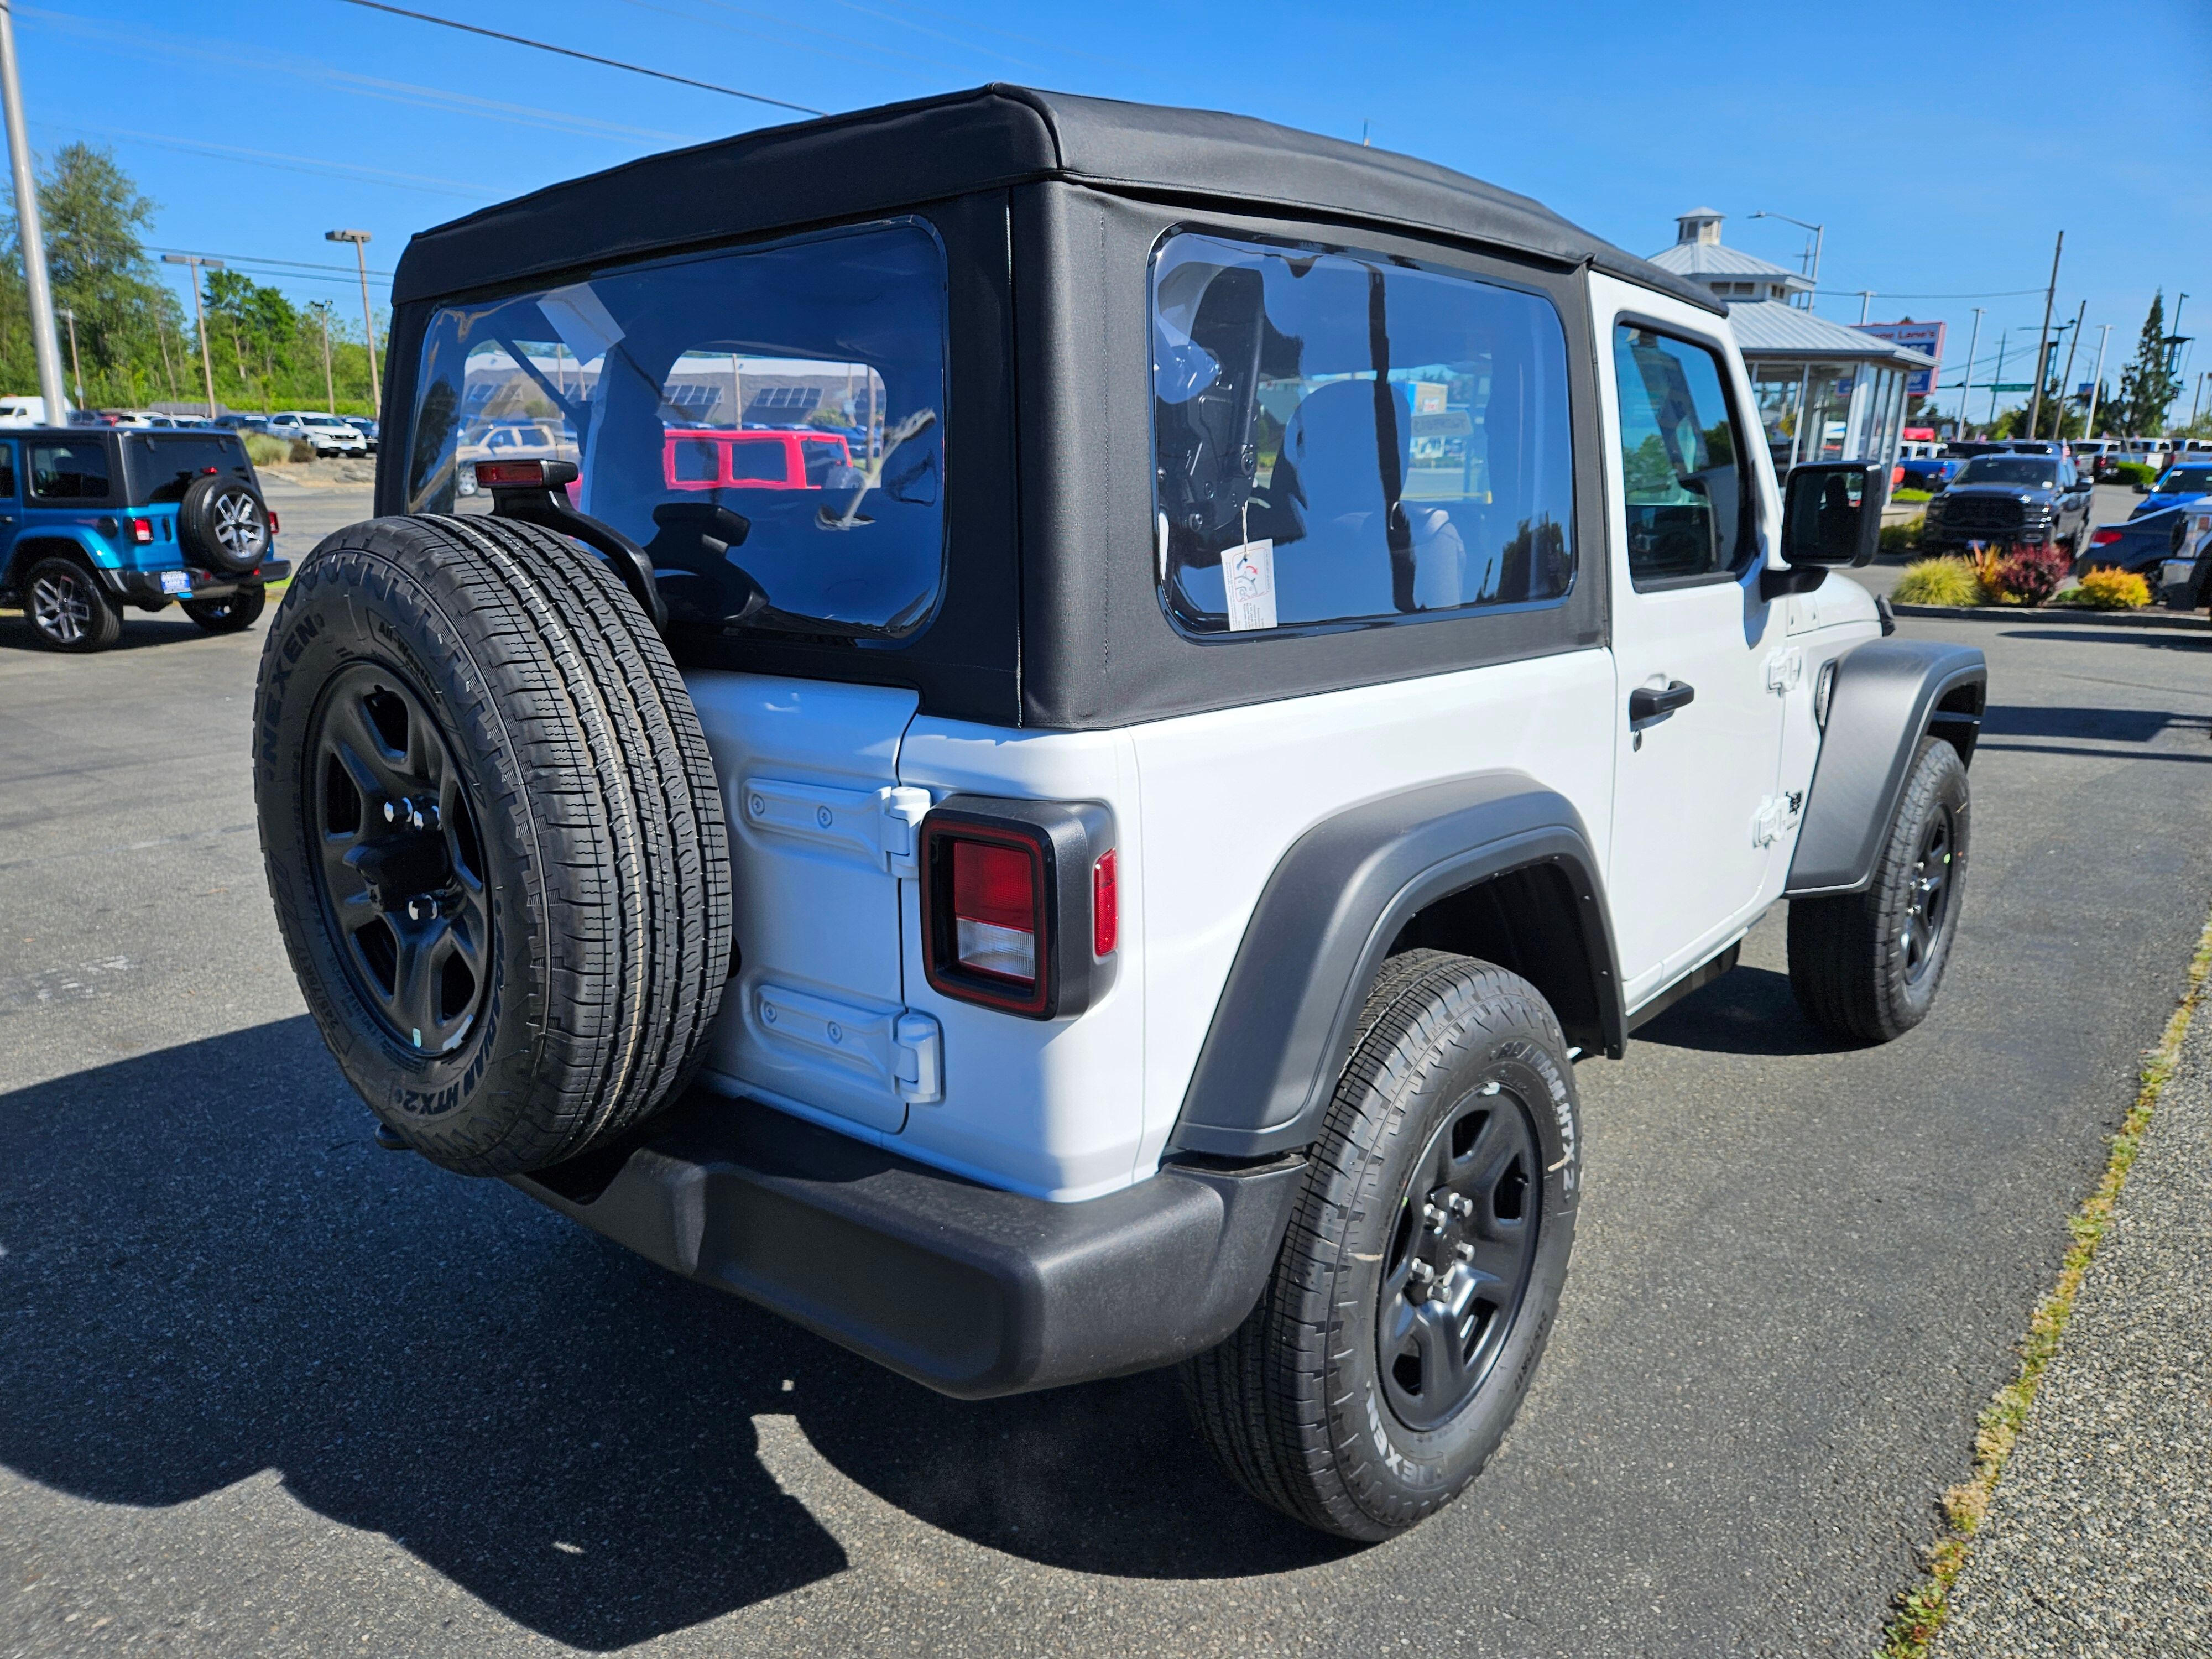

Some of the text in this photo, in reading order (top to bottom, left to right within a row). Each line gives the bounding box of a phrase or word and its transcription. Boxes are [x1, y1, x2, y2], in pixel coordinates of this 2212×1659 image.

[1898, 329, 1934, 340] Lane's
[262, 614, 319, 765] NEXEN
[463, 918, 505, 1097] ROADIAN
[1366, 1389, 1435, 1484] NEXEN
